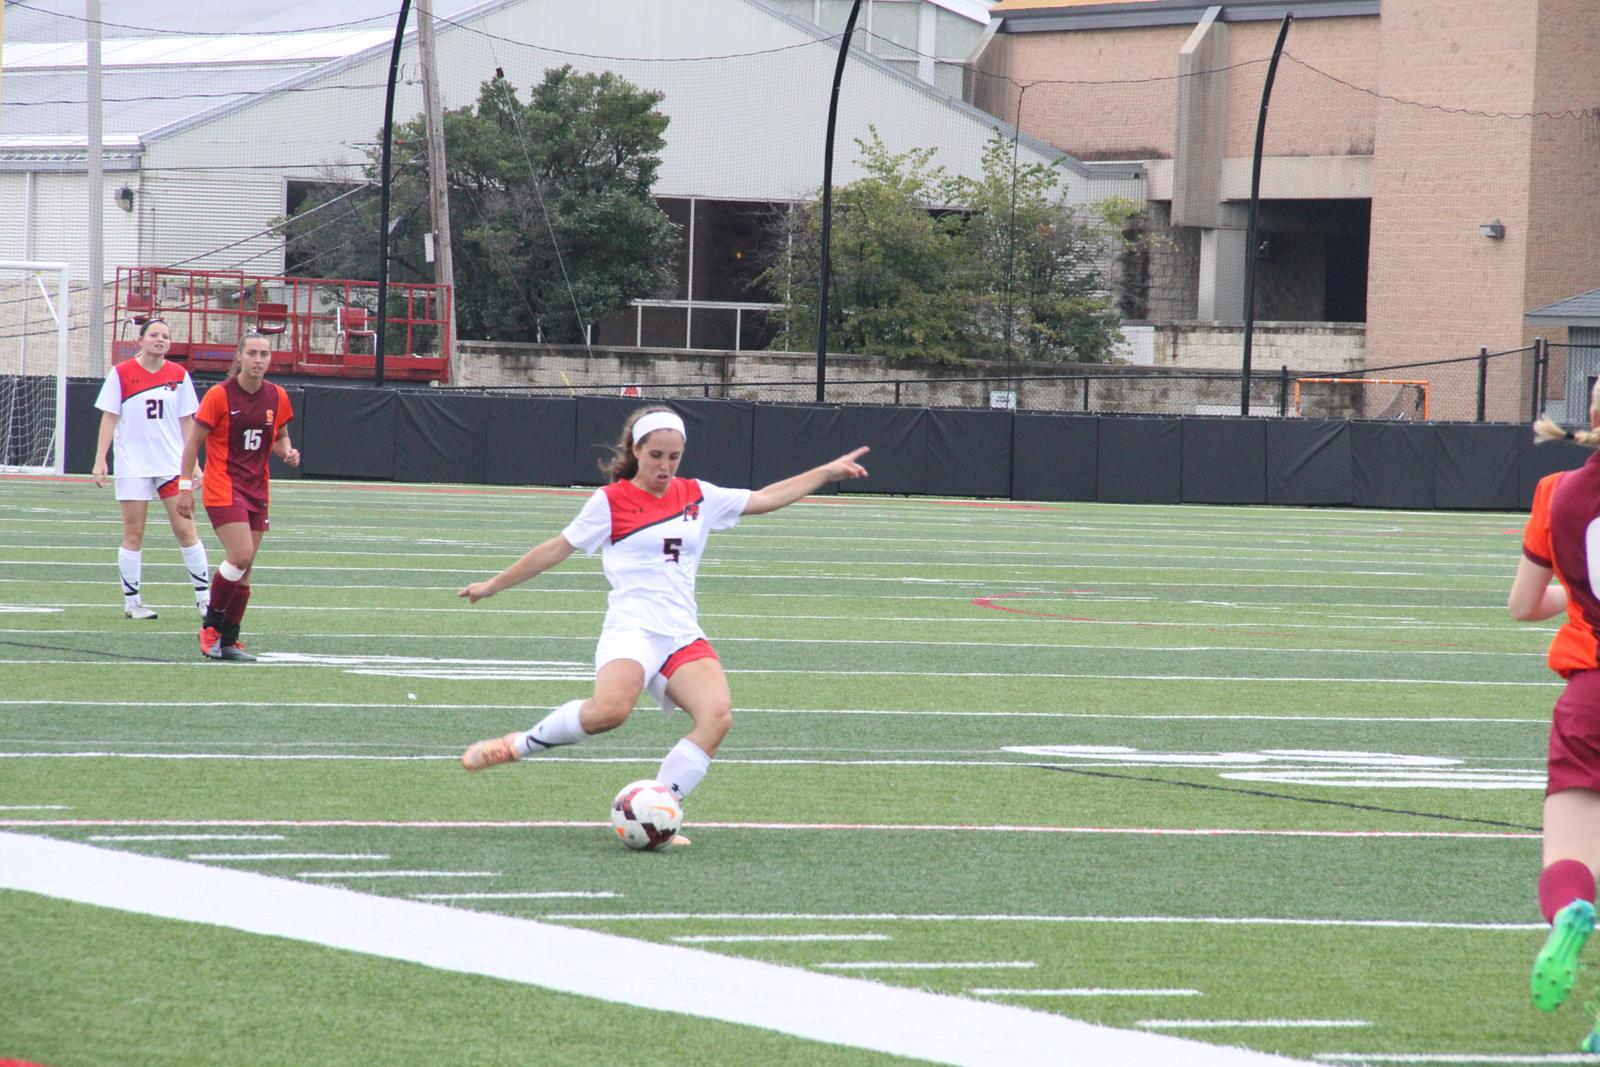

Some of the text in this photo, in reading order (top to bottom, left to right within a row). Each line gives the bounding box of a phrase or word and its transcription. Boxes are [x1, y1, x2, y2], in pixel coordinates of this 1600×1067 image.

[145, 399, 164, 419] 21
[243, 429, 263, 451] 15
[663, 538, 682, 565] 5
